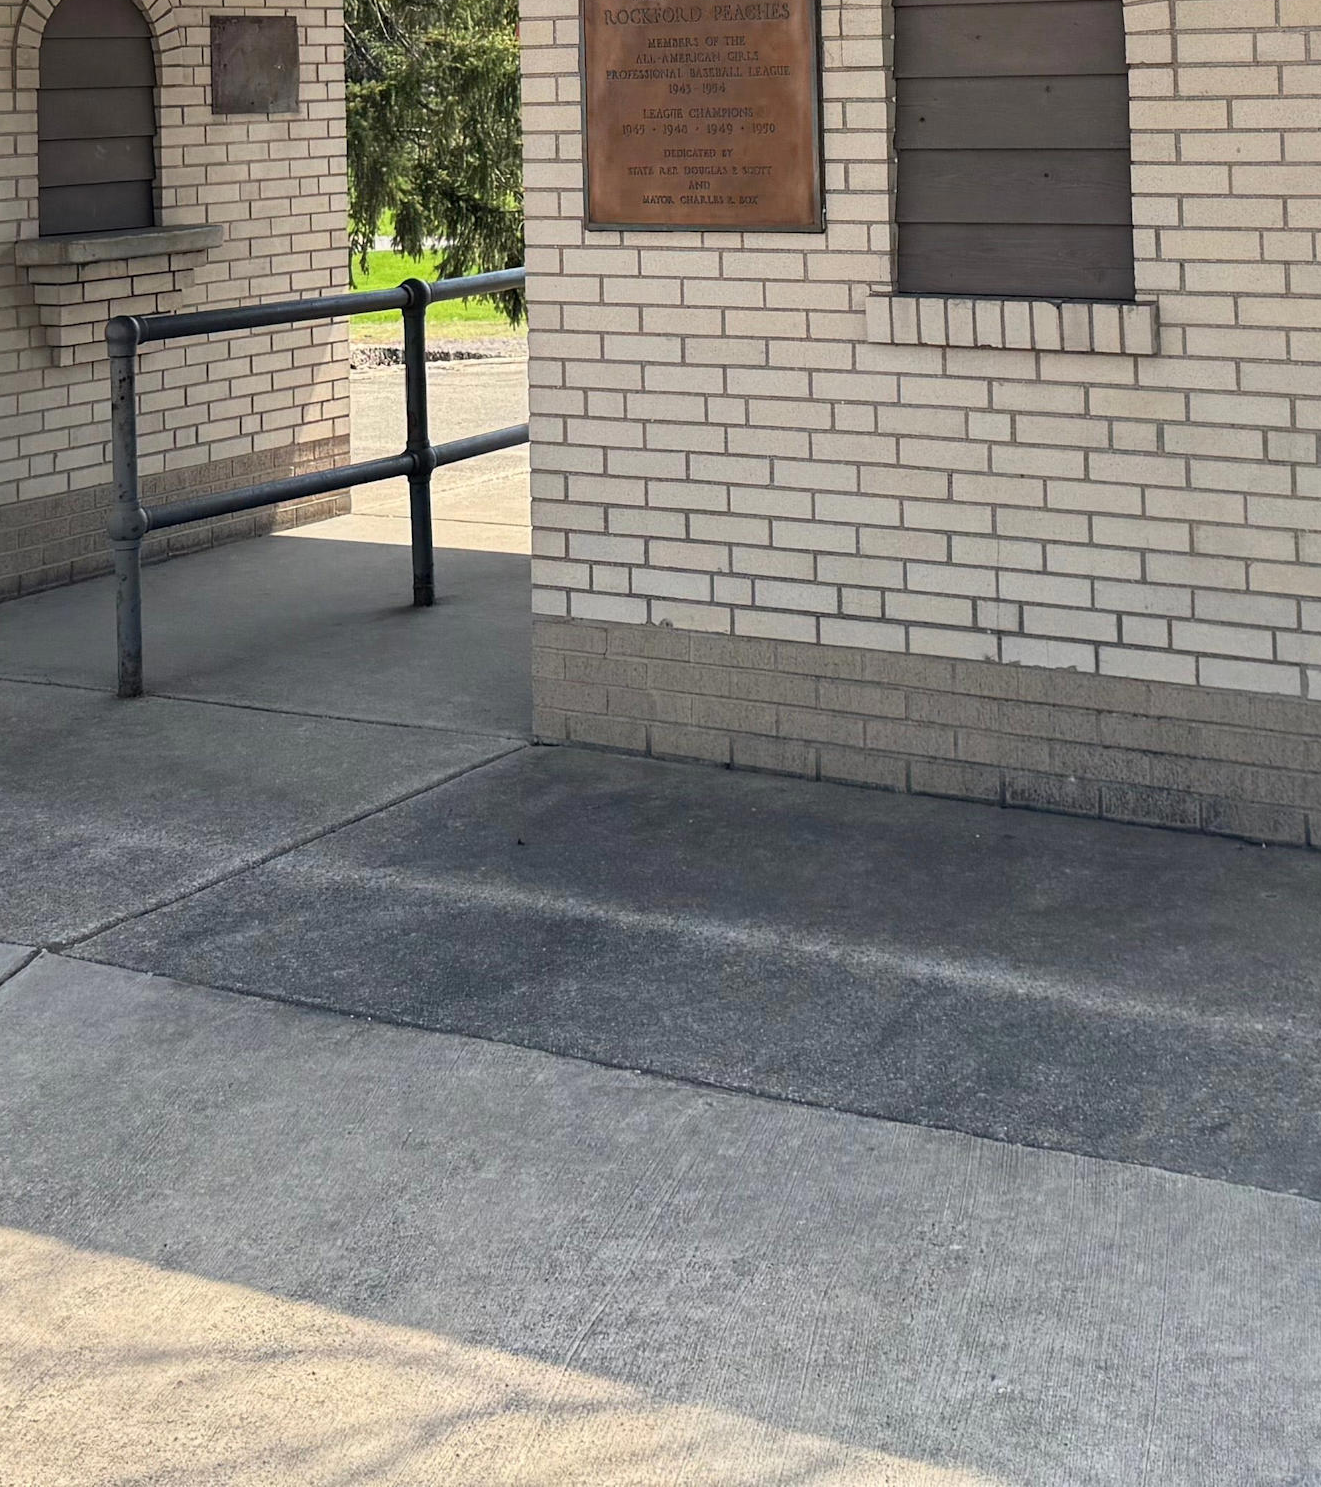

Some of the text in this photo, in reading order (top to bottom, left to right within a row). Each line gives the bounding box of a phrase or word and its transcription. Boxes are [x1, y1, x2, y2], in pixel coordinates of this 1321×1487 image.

[604, 2, 791, 26] ROCKFORD PEACHES
[648, 36, 746, 49] MEMBERS OF THE
[636, 51, 759, 64] ALL-AMERICAN GIRLS
[606, 65, 791, 81] PROFESSIONAL BASEBALL LEAGUE
[642, 107, 754, 120] LEAGUE CHAMPIONS
[706, 123, 733, 135] 1949
[752, 122, 776, 135] 1950
[663, 148, 716, 159] DEDICATED
[688, 180, 711, 191] AND
